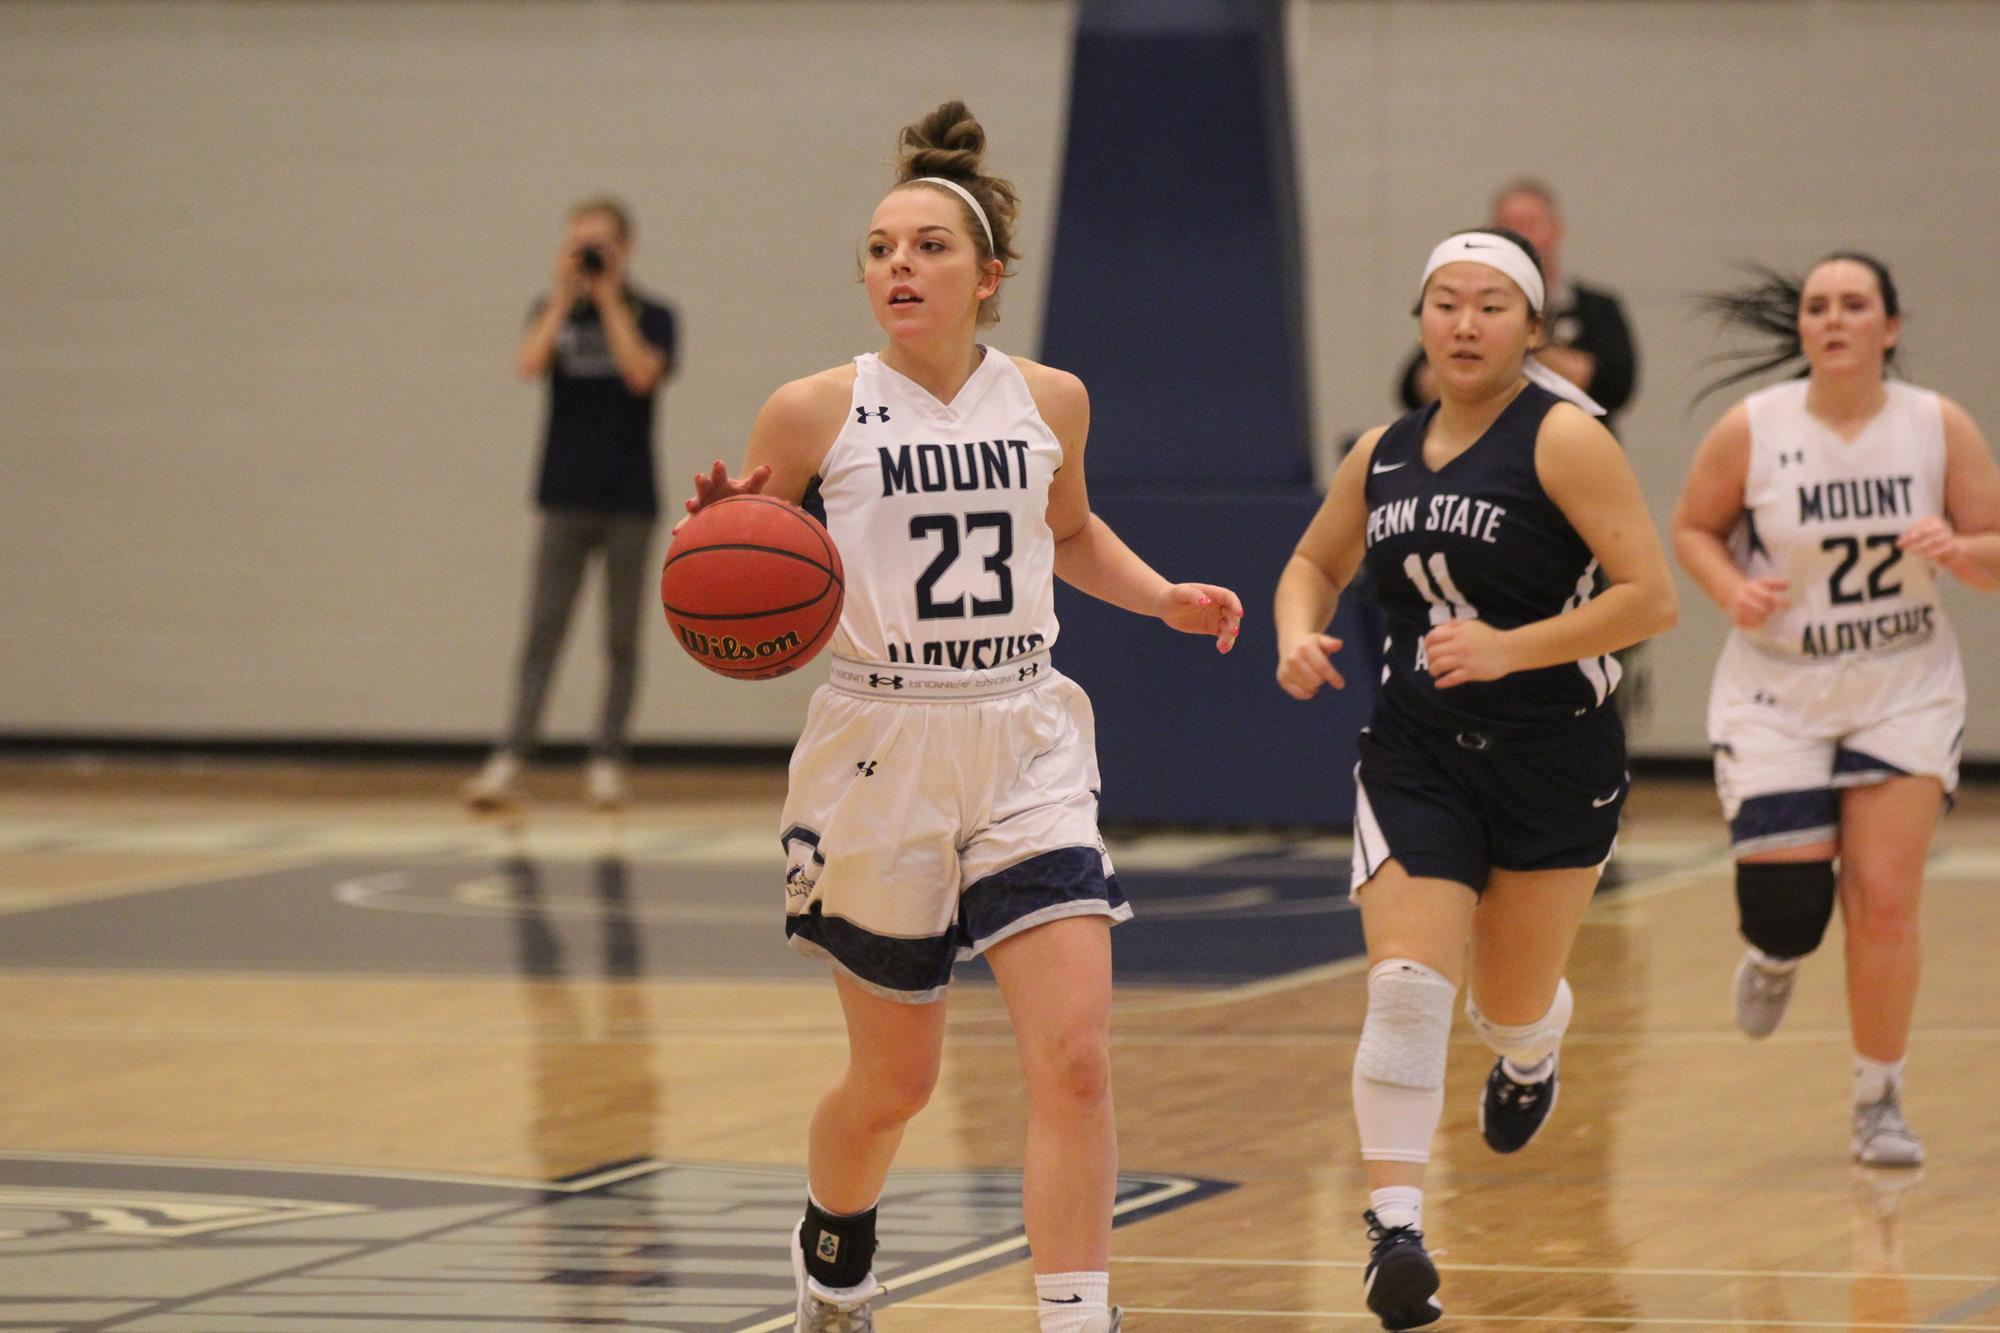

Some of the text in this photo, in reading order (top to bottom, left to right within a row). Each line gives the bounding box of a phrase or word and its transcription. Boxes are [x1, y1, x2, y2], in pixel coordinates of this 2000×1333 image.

[878, 440, 1030, 497] MOUNT
[1367, 495, 1507, 548] PENN STATE
[1797, 477, 1914, 526] MOUNT
[908, 510, 1015, 622] 23
[1403, 552, 1479, 626] 11
[1820, 533, 1904, 607] 22
[678, 623, 801, 661] Wilson
